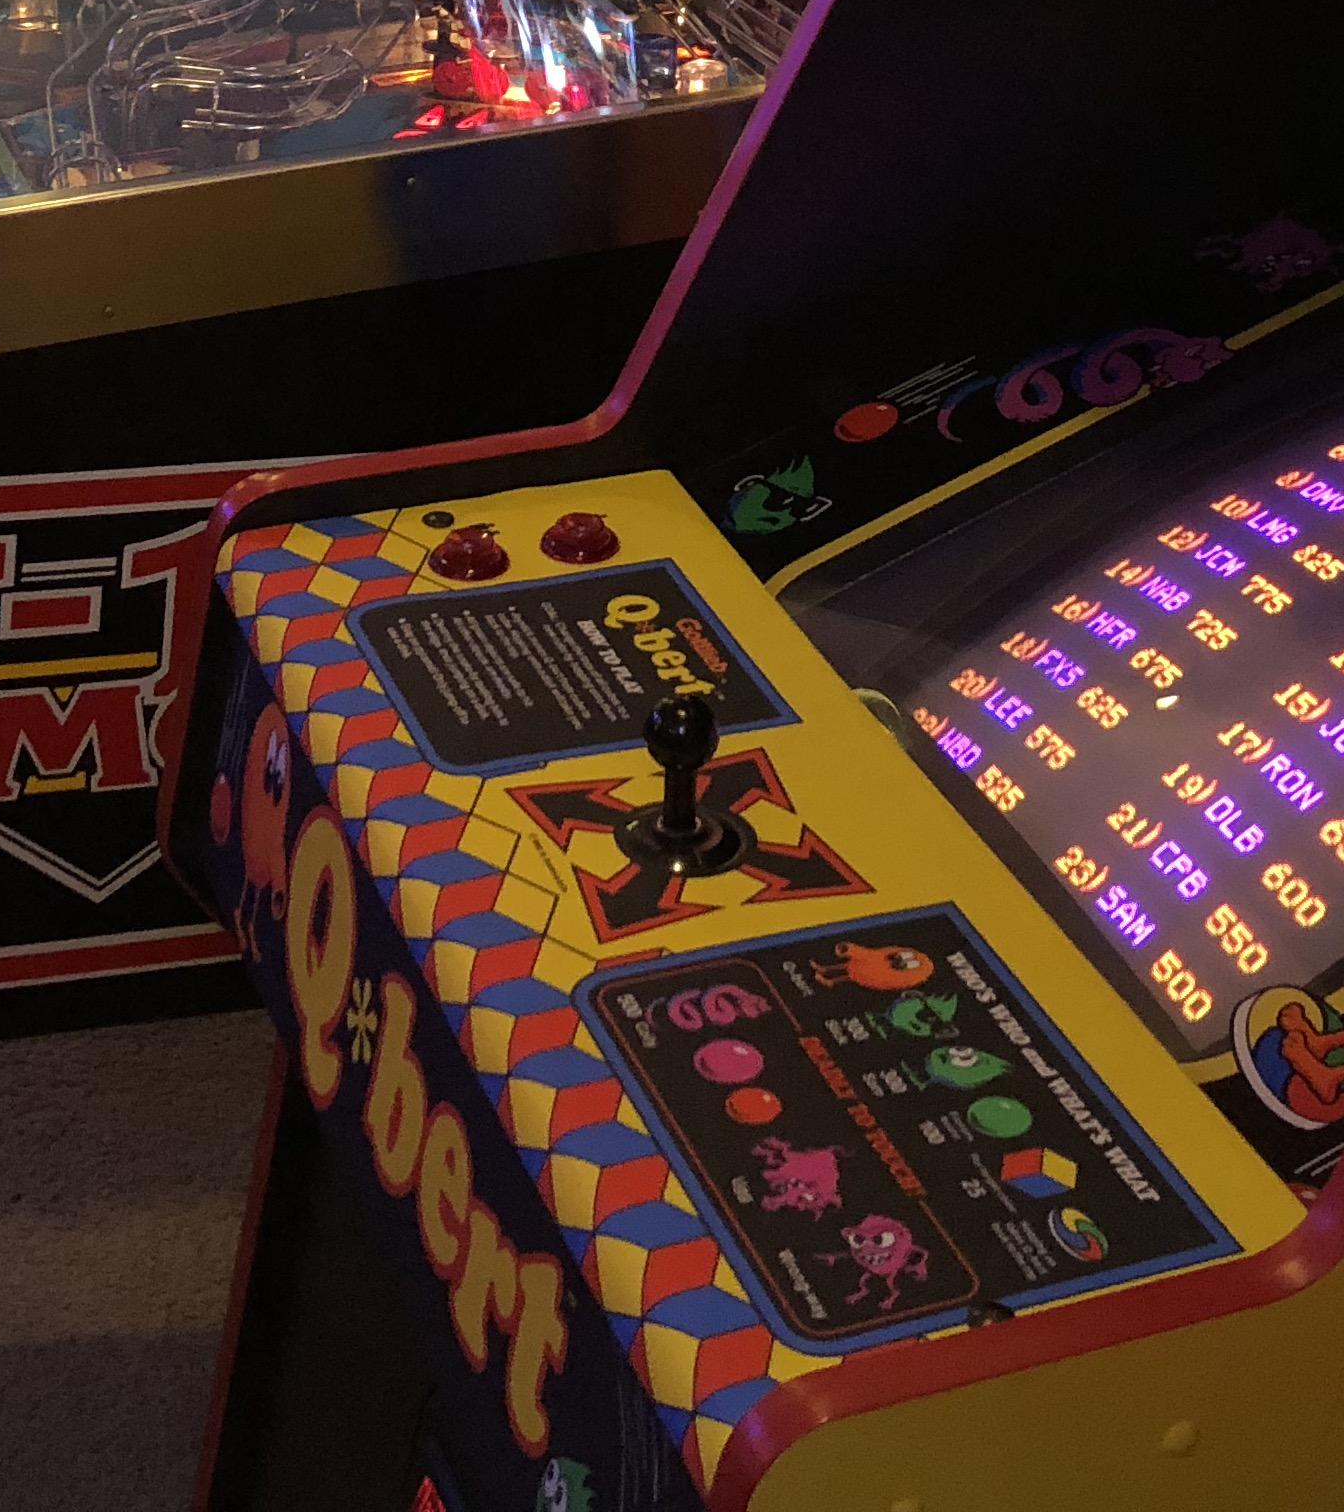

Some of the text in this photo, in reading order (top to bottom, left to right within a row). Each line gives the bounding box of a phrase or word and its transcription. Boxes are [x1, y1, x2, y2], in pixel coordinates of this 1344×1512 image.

[1244, 509, 1299, 547] LMG
[1138, 575, 1193, 613] NAB
[1187, 608, 1239, 651] 725
[1193, 544, 1247, 578] JCM
[1241, 574, 1294, 615] 775
[576, 619, 644, 694] HOW TO PLAY
[1128, 647, 1184, 690] 675
[984, 688, 1034, 731] LEE
[1024, 724, 1077, 771] 575
[1076, 686, 1129, 730] 625
[975, 763, 1025, 813] 525
[1260, 752, 1325, 813] RON
[1203, 795, 1267, 857] DLB
[1260, 862, 1328, 928] 600
[1148, 840, 1211, 901] CPB
[1204, 903, 1269, 975] 550
[1096, 885, 1156, 949] SAM
[1151, 948, 1214, 1020] 500
[946, 951, 997, 1003] WHO'S
[988, 1003, 1031, 1045] WHO
[1047, 1079, 1113, 1145] WHAT'S
[1104, 1145, 1161, 1202] WHAT
[961, 1178, 987, 1199] 25
